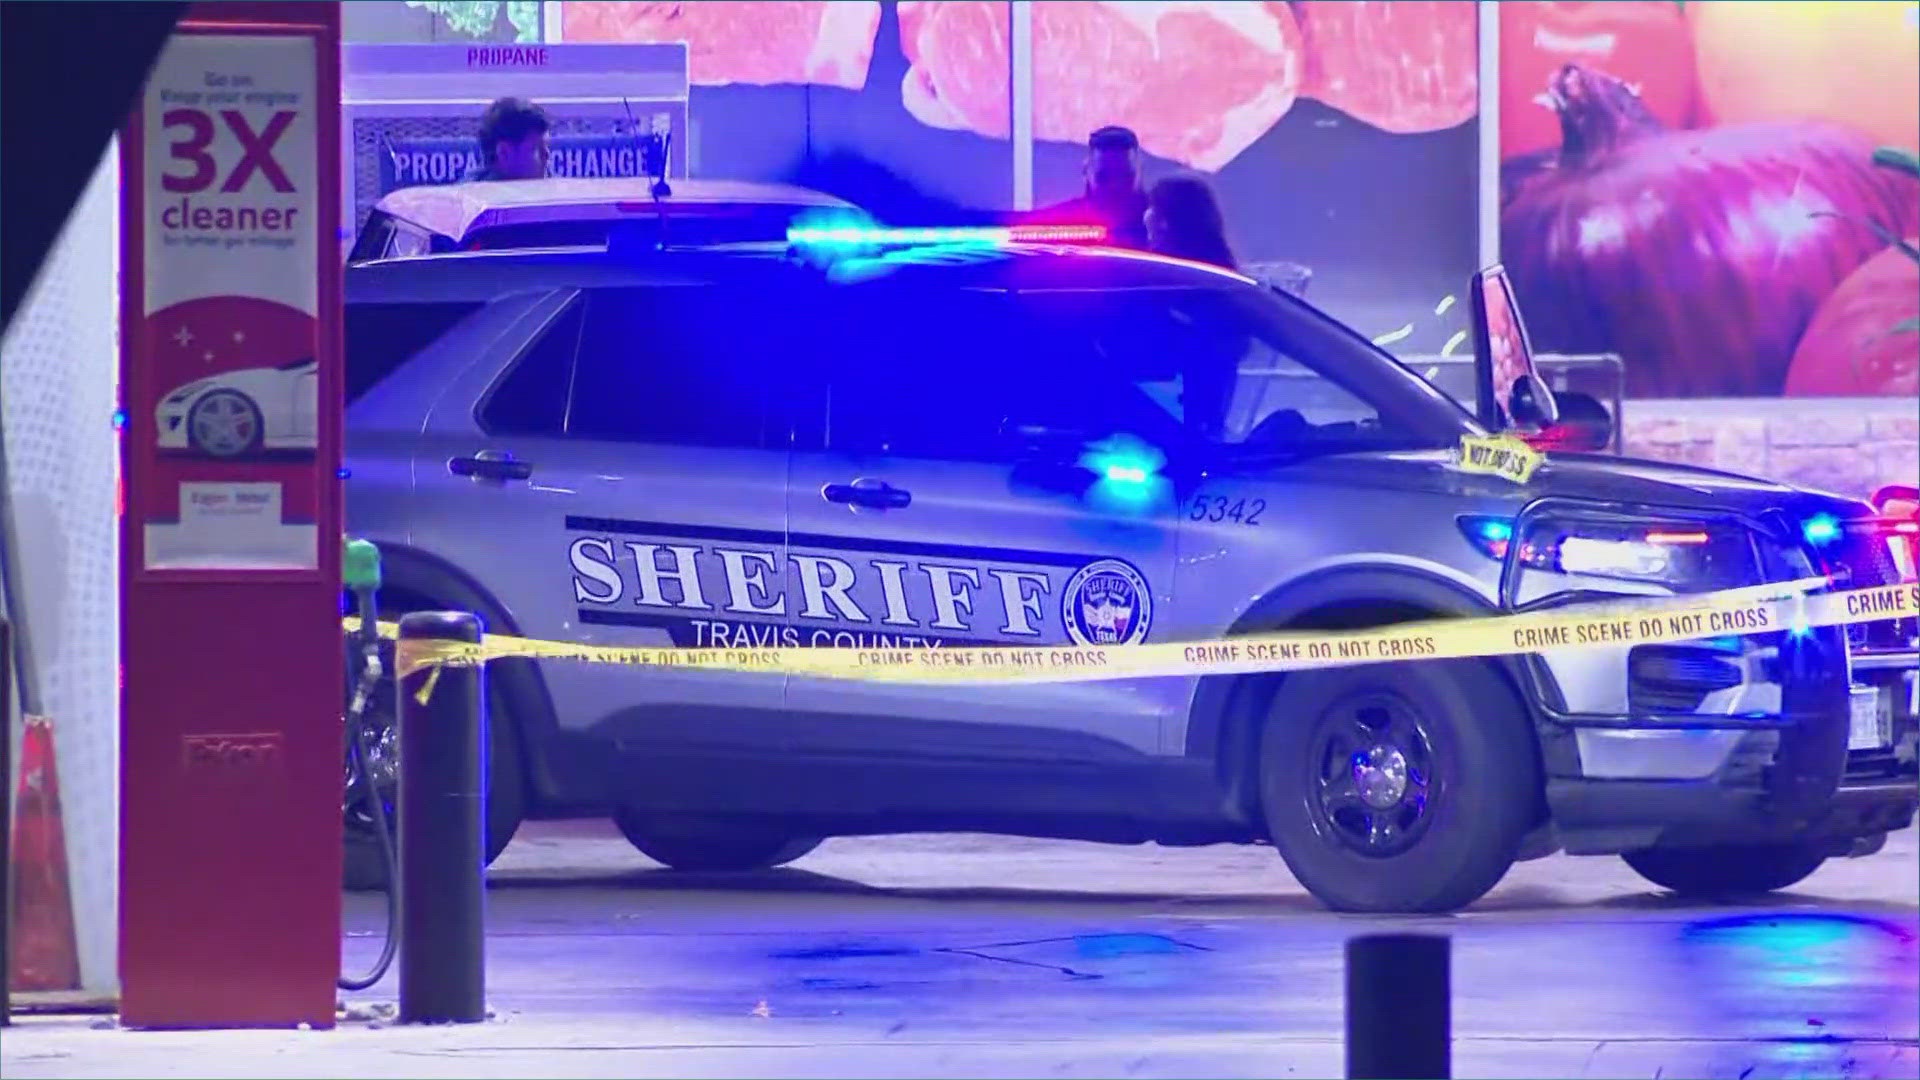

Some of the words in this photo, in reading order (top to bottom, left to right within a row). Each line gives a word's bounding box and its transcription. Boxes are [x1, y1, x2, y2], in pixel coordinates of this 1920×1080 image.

[466, 47, 549, 67] PROPANE
[161, 109, 298, 193] 3X
[395, 151, 485, 182] PROPA
[548, 148, 648, 178] CHANGE
[161, 197, 298, 231] cleaner
[1189, 494, 1267, 525] 5342
[568, 537, 1052, 637] SHERIFF
[1847, 589, 1906, 616] CRIME
[690, 620, 800, 648] TRAVIS
[1513, 626, 1570, 648] CRIME
[1576, 620, 1633, 644] SCENE
[1639, 618, 1664, 639] DO
[1669, 615, 1702, 636] NOT
[1710, 607, 1769, 632] CROSS
[858, 651, 914, 667] CRIME
[920, 651, 973, 667] SCENE
[1010, 650, 1044, 667] NOT
[1050, 650, 1108, 667] CROSS
[1183, 645, 1239, 664] CRIME
[1247, 643, 1301, 662] SCENE
[1308, 641, 1332, 660] DO
[1338, 639, 1372, 659] NOT
[1378, 636, 1436, 657] CROSS
